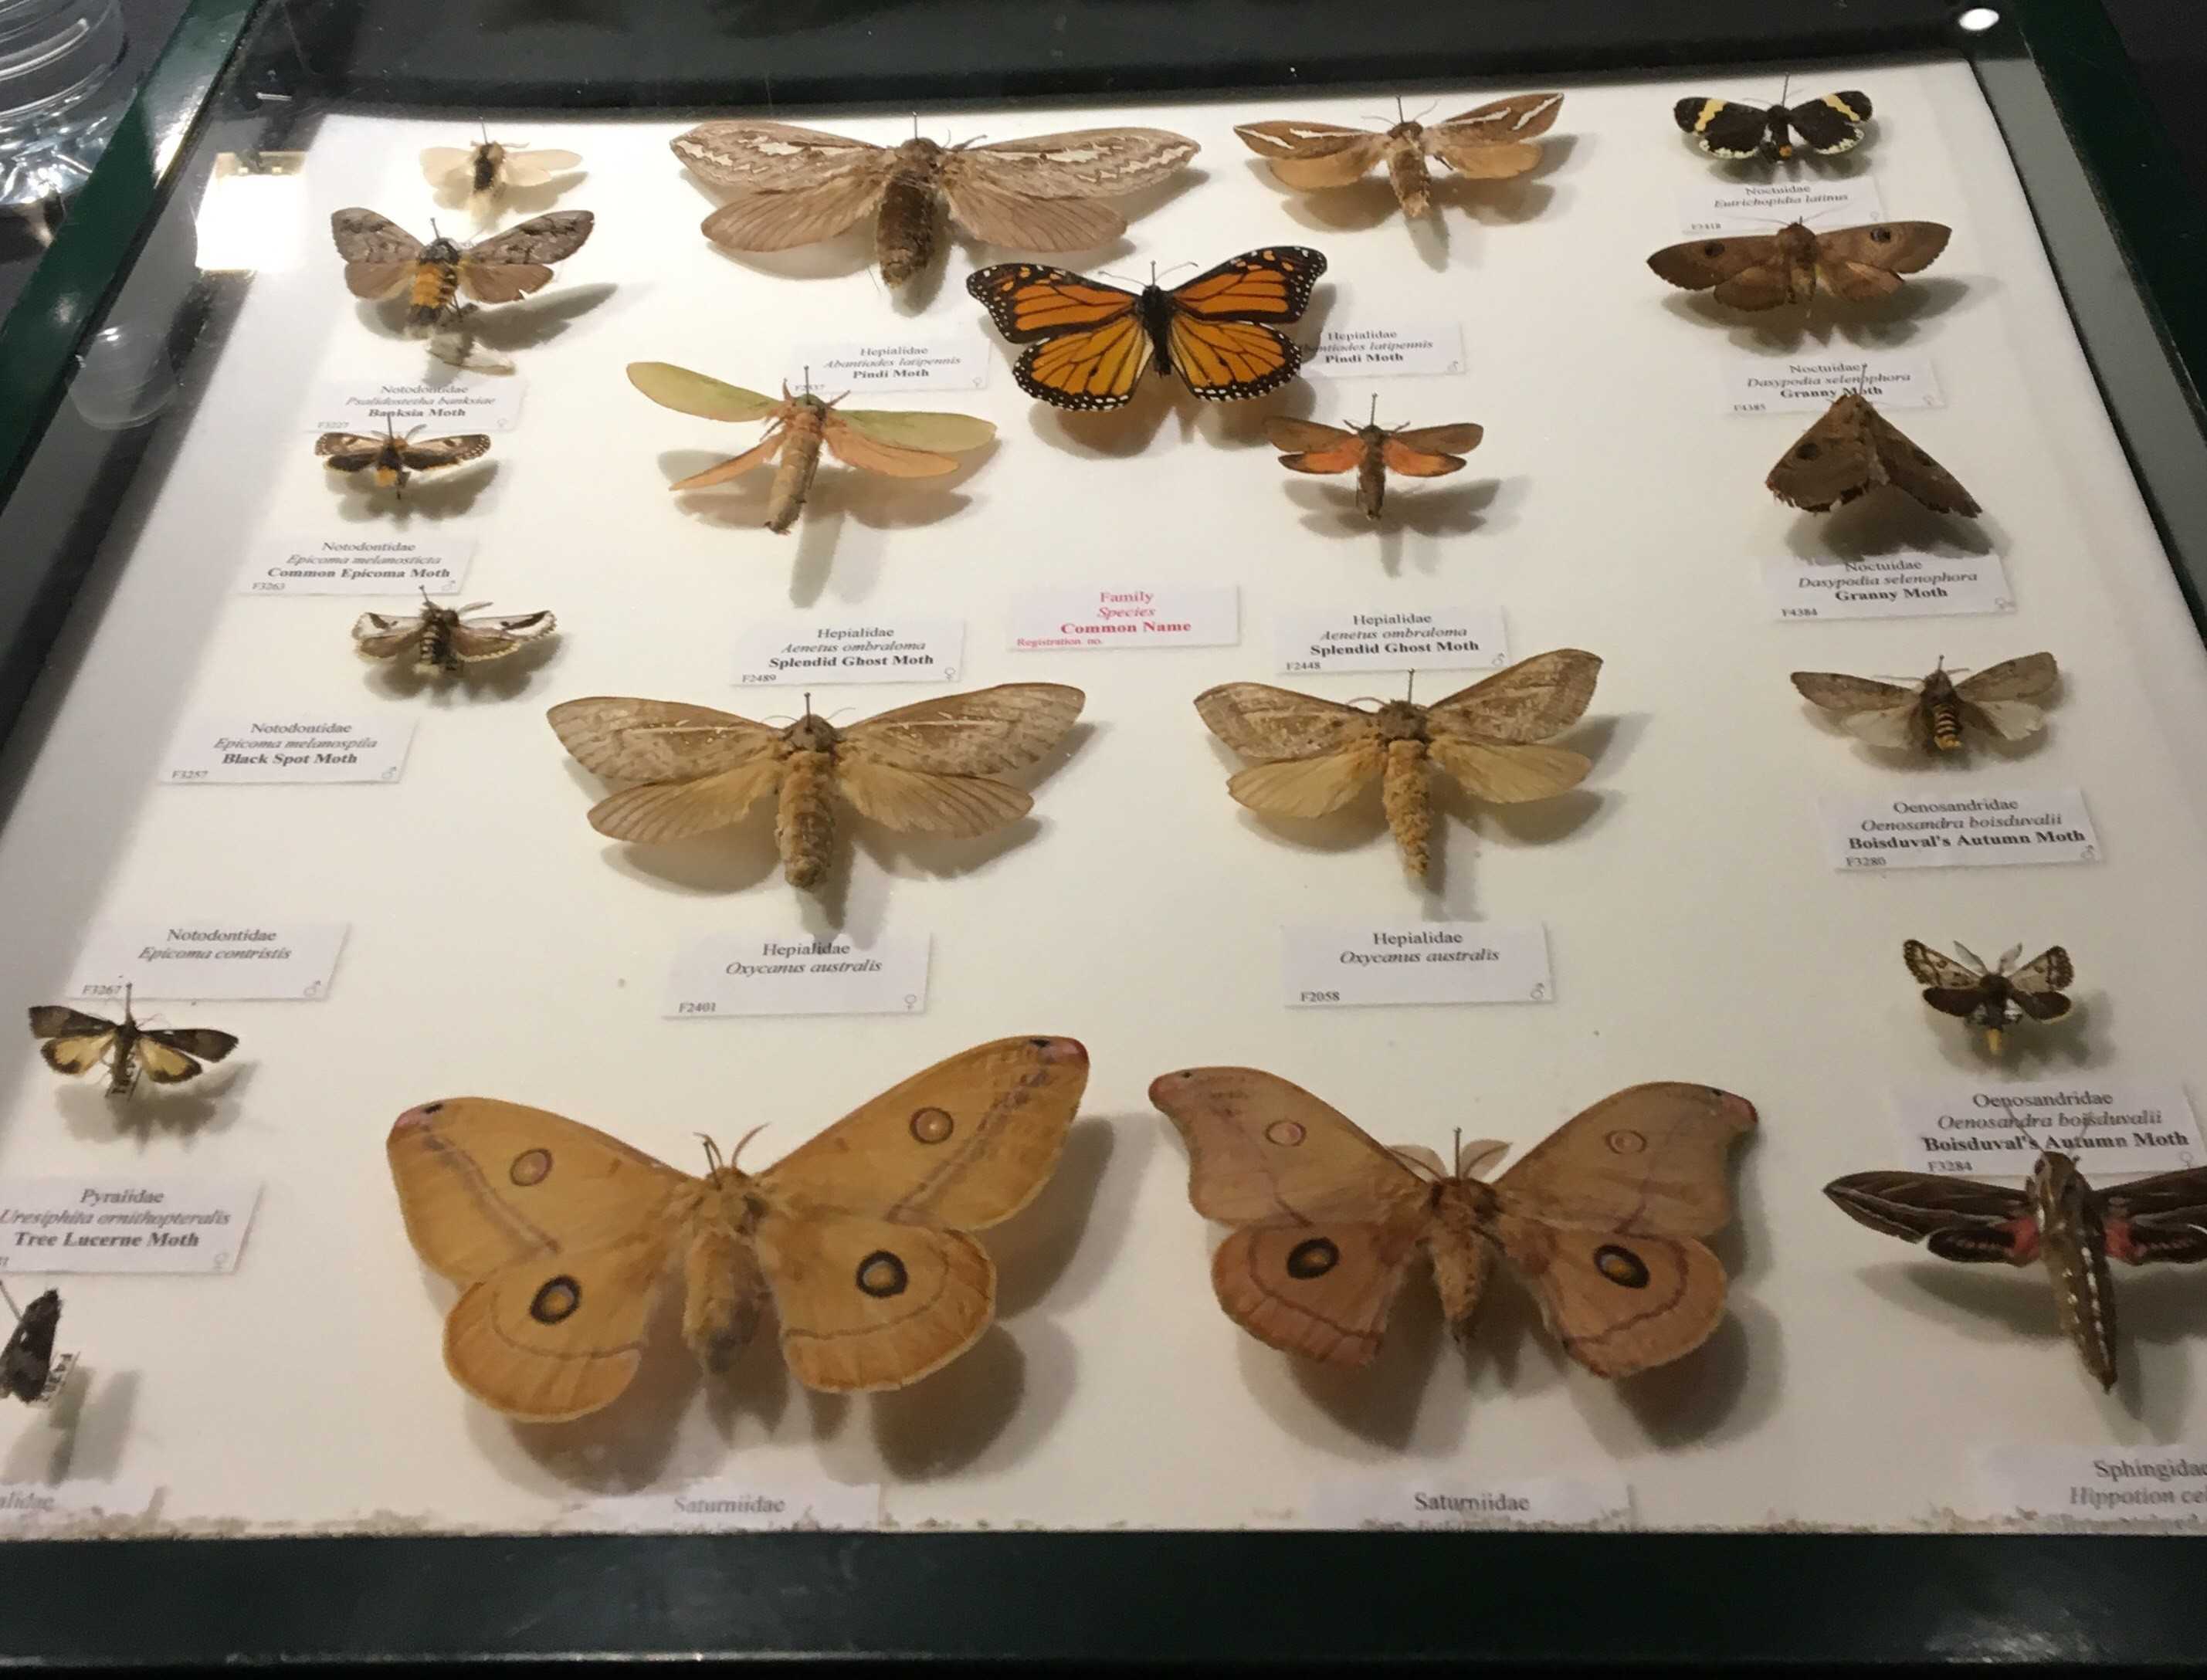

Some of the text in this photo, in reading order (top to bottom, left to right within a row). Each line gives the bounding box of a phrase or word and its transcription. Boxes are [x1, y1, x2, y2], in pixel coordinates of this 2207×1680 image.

[1328, 331, 1398, 342] Hepialidae
[860, 347, 928, 357] Hepialidae
[1325, 352, 1403, 364] Pindi Moth
[853, 369, 929, 379] Pindi Moth
[1789, 364, 1860, 374] Noctuidae
[1780, 386, 1883, 398] Granny Moth
[368, 408, 466, 417] Banksia Moth
[322, 542, 415, 552] Notodontidae
[286, 554, 349, 566] Epicoma
[1845, 561, 1923, 572] Noctuidae
[268, 568, 450, 579] Common Epicoma Moth
[1798, 572, 1978, 589] Dasypodia selenophora
[1100, 591, 1154, 605] Family
[1835, 587, 1948, 602] Granny Moth
[1097, 607, 1156, 620] Species
[1353, 614, 1432, 626] Hepialidae
[817, 628, 894, 640] Hepialidae
[1061, 622, 1192, 635] Common Name
[1320, 630, 1378, 640] Aenetus
[781, 641, 926, 653] Aenetus ombraloma
[1017, 637, 1081, 649] Registration
[1310, 641, 1480, 657] Splendid Ghost Moth
[769, 655, 934, 670] Splendid Ghost Moth
[251, 723, 351, 733] Notodontidae
[213, 738, 281, 750] Epicoma
[222, 753, 357, 766] Black Spot Moth
[1893, 798, 2019, 815] Oenosandridae
[1861, 814, 2062, 832] Oenosandra boisduvalii
[1849, 830, 2085, 849] Boisduval's Autumn Moth
[167, 929, 277, 941] Notodontidae
[1372, 931, 1463, 947] Hepialidae
[138, 947, 292, 961] Epicoma contristis
[762, 942, 850, 959] Hepialidae
[1340, 948, 1500, 967] Oxycanus australis
[726, 959, 883, 977] Oxycanus australis
[1300, 991, 1341, 1002] F2058
[1973, 1091, 2114, 1107] Oenosandridae
[1937, 1110, 2162, 1130] Oenosandra boisduvalii
[1921, 1130, 2189, 1152] Boisduval's Autumn Moth
[15, 1231, 199, 1247] Tree Lucerne Moth
[674, 1494, 787, 1513] Saturniidae
[1414, 1491, 1531, 1512] Saturniidae
[2070, 1486, 2175, 1510] Hippotion
